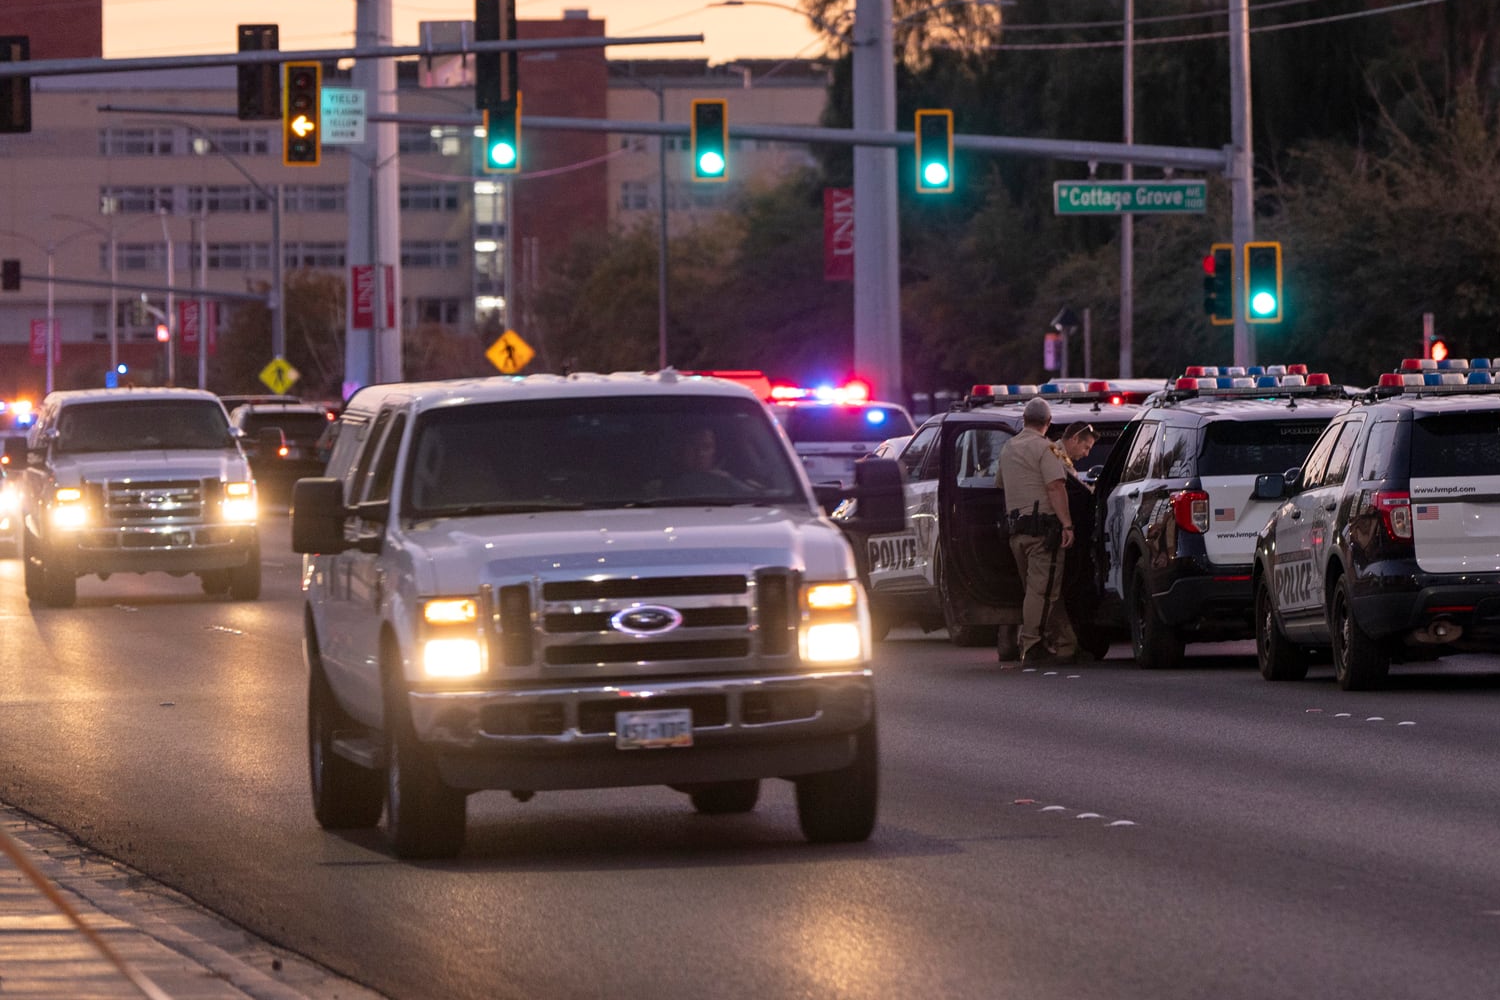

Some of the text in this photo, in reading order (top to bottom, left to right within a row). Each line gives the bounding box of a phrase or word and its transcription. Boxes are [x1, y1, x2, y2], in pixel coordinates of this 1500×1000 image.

[329, 94, 359, 104] YIELD
[1069, 187, 1132, 211] Cottage
[1136, 187, 1184, 206] Grove
[1414, 485, 1477, 495] www.lvmpd.com
[871, 538, 916, 571] POLICE
[1275, 562, 1312, 606] POLICE
